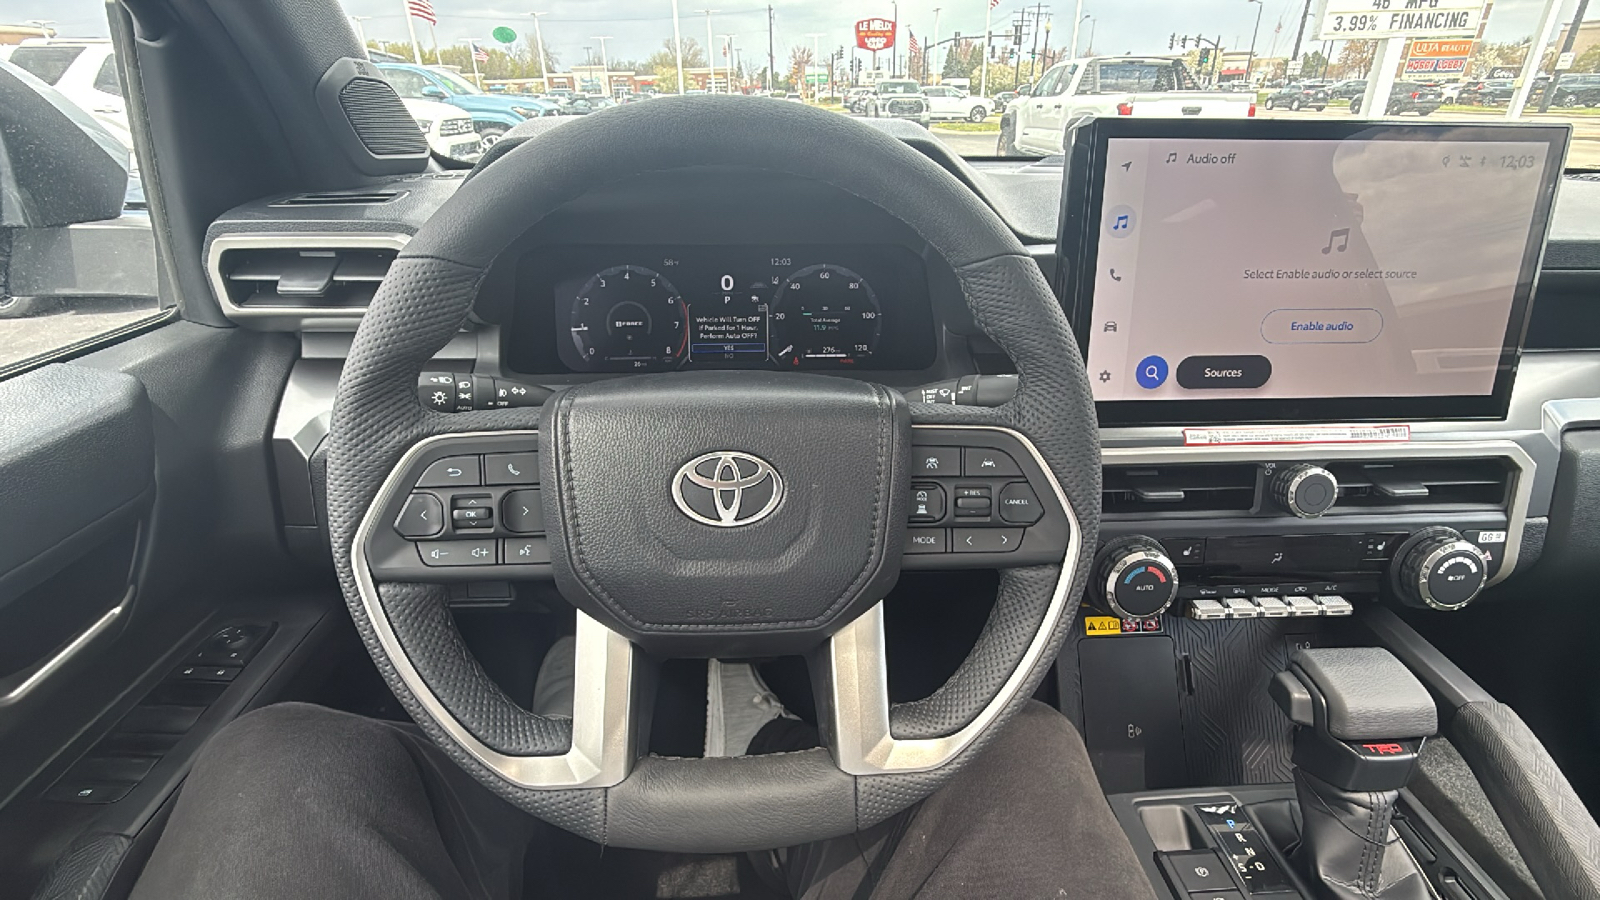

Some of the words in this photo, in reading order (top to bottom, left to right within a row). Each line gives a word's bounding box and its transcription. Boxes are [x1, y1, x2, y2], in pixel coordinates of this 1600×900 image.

[1333, 15, 1378, 32] 3.99%
[1389, 12, 1469, 30] FINANCING
[1413, 42, 1440, 55] ULTA
[1406, 60, 1434, 70] HOBBY
[1437, 59, 1464, 70] LOBBY
[1186, 153, 1219, 164] Audio
[1220, 153, 1236, 164] off
[1500, 154, 1535, 170] 12:03
[770, 258, 792, 266] 12:03
[1244, 269, 1274, 279] Select
[1276, 269, 1310, 279] Enable
[1312, 268, 1340, 279] audio
[1342, 271, 1352, 279] or
[1354, 268, 1383, 279] select
[1384, 270, 1418, 279] source
[720, 274, 734, 290] 0
[724, 296, 730, 304] P
[775, 312, 786, 320] 20
[674, 321, 680, 329] 7
[1290, 321, 1324, 331] Enable
[1325, 320, 1354, 331] audio
[666, 346, 672, 354] 8
[1204, 368, 1243, 378] Sources
[1226, 820, 1235, 829] P
[1234, 832, 1247, 842] R
